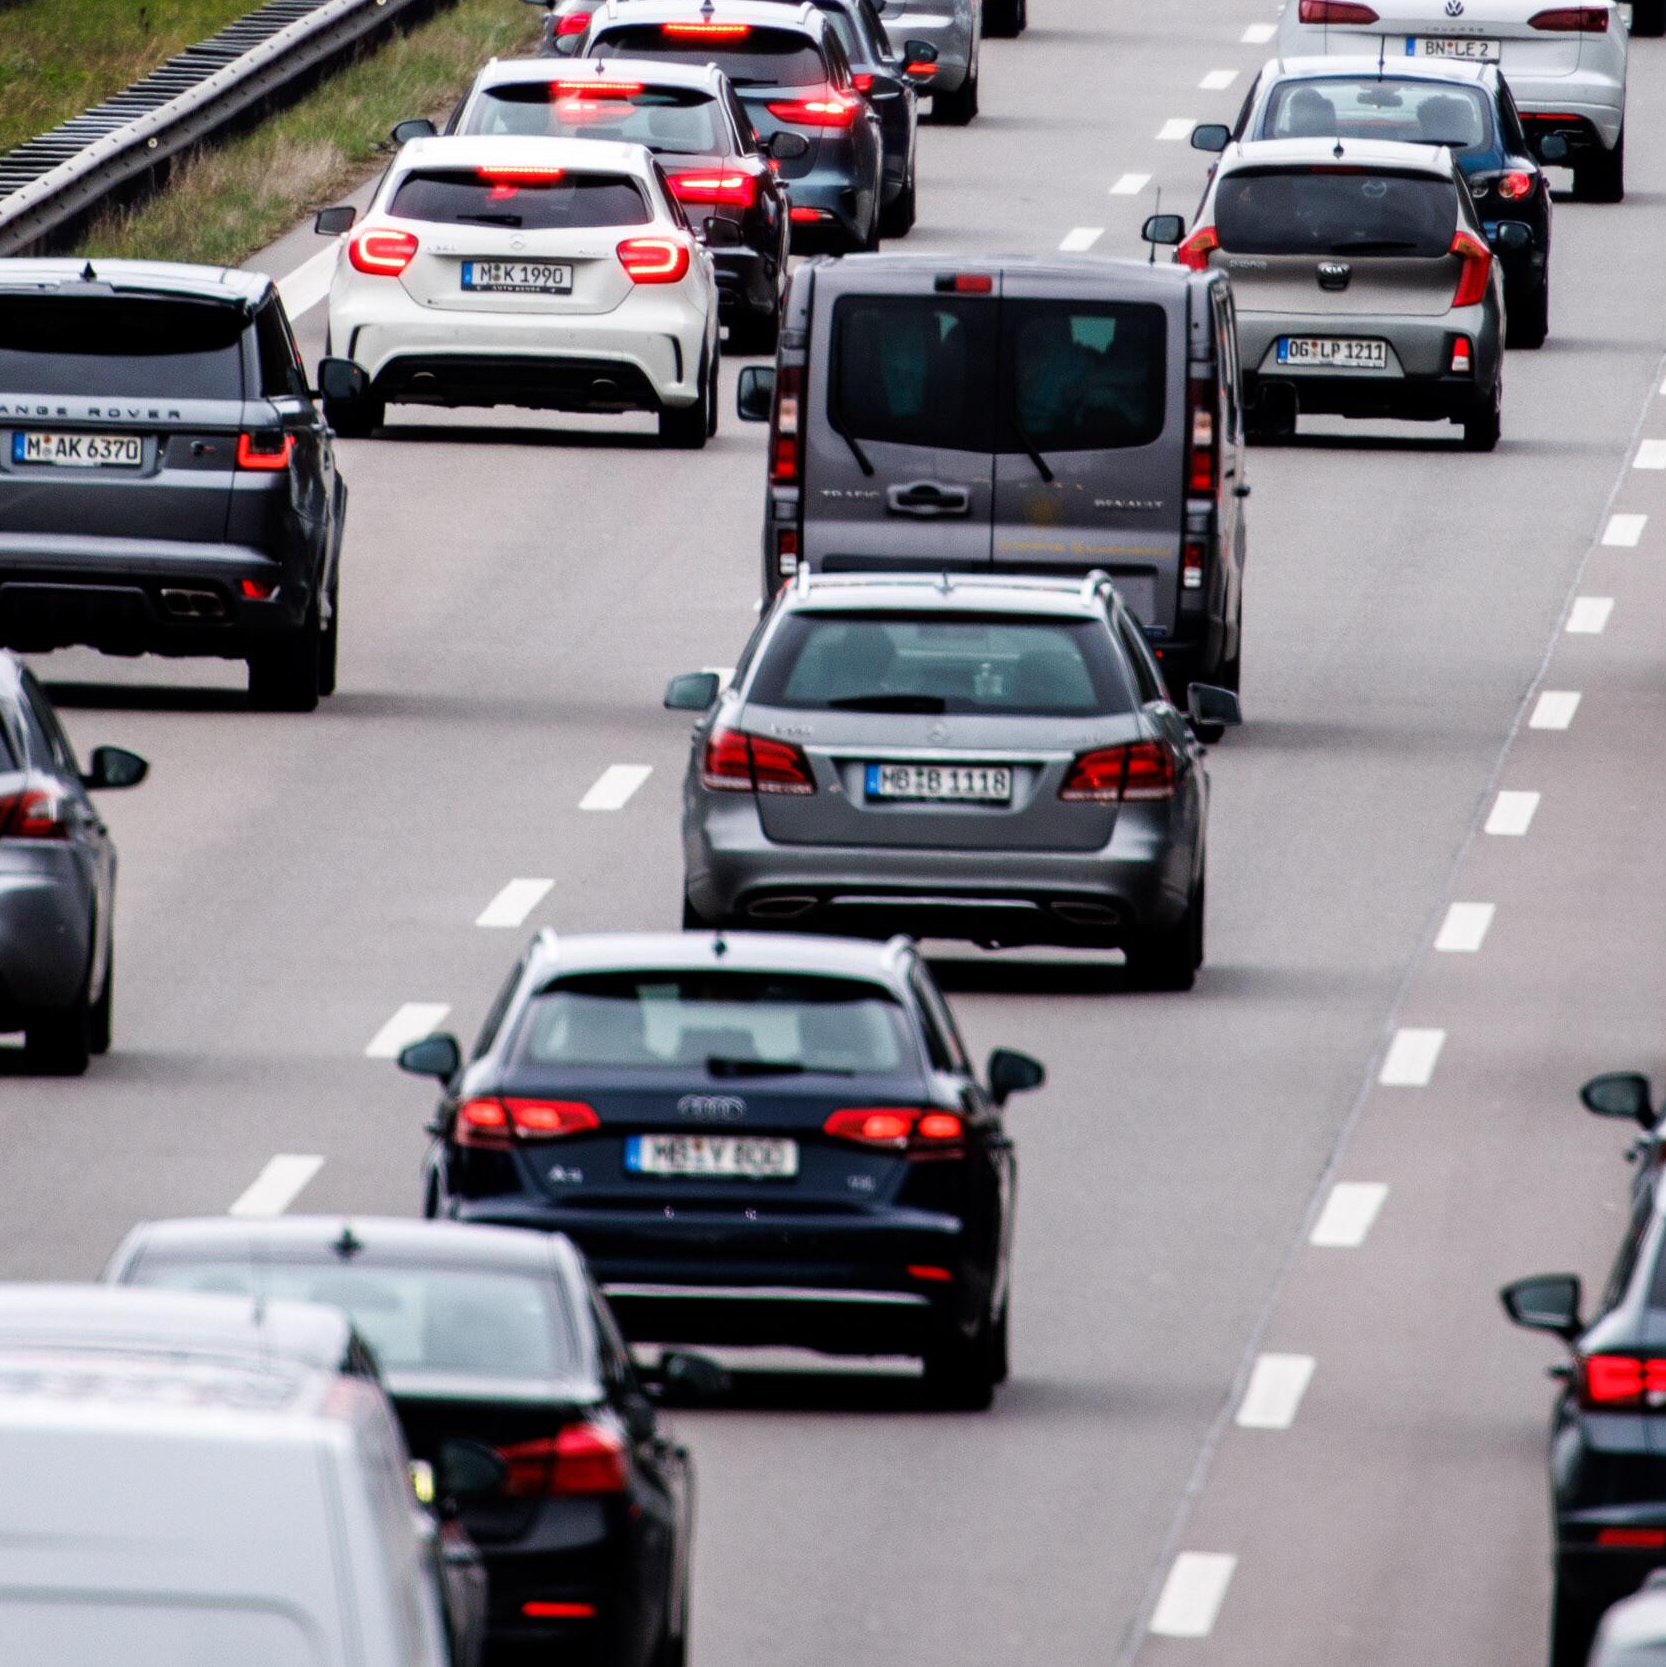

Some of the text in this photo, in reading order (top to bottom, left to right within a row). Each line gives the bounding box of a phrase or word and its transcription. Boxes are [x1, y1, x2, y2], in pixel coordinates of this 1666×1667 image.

[1425, 40, 1488, 57] BN LE 2
[480, 264, 564, 284] M K 1990
[1289, 341, 1383, 360] OG LP 1211
[88, 407, 182, 420] ROVER
[27, 438, 139, 460] M AK 6370
